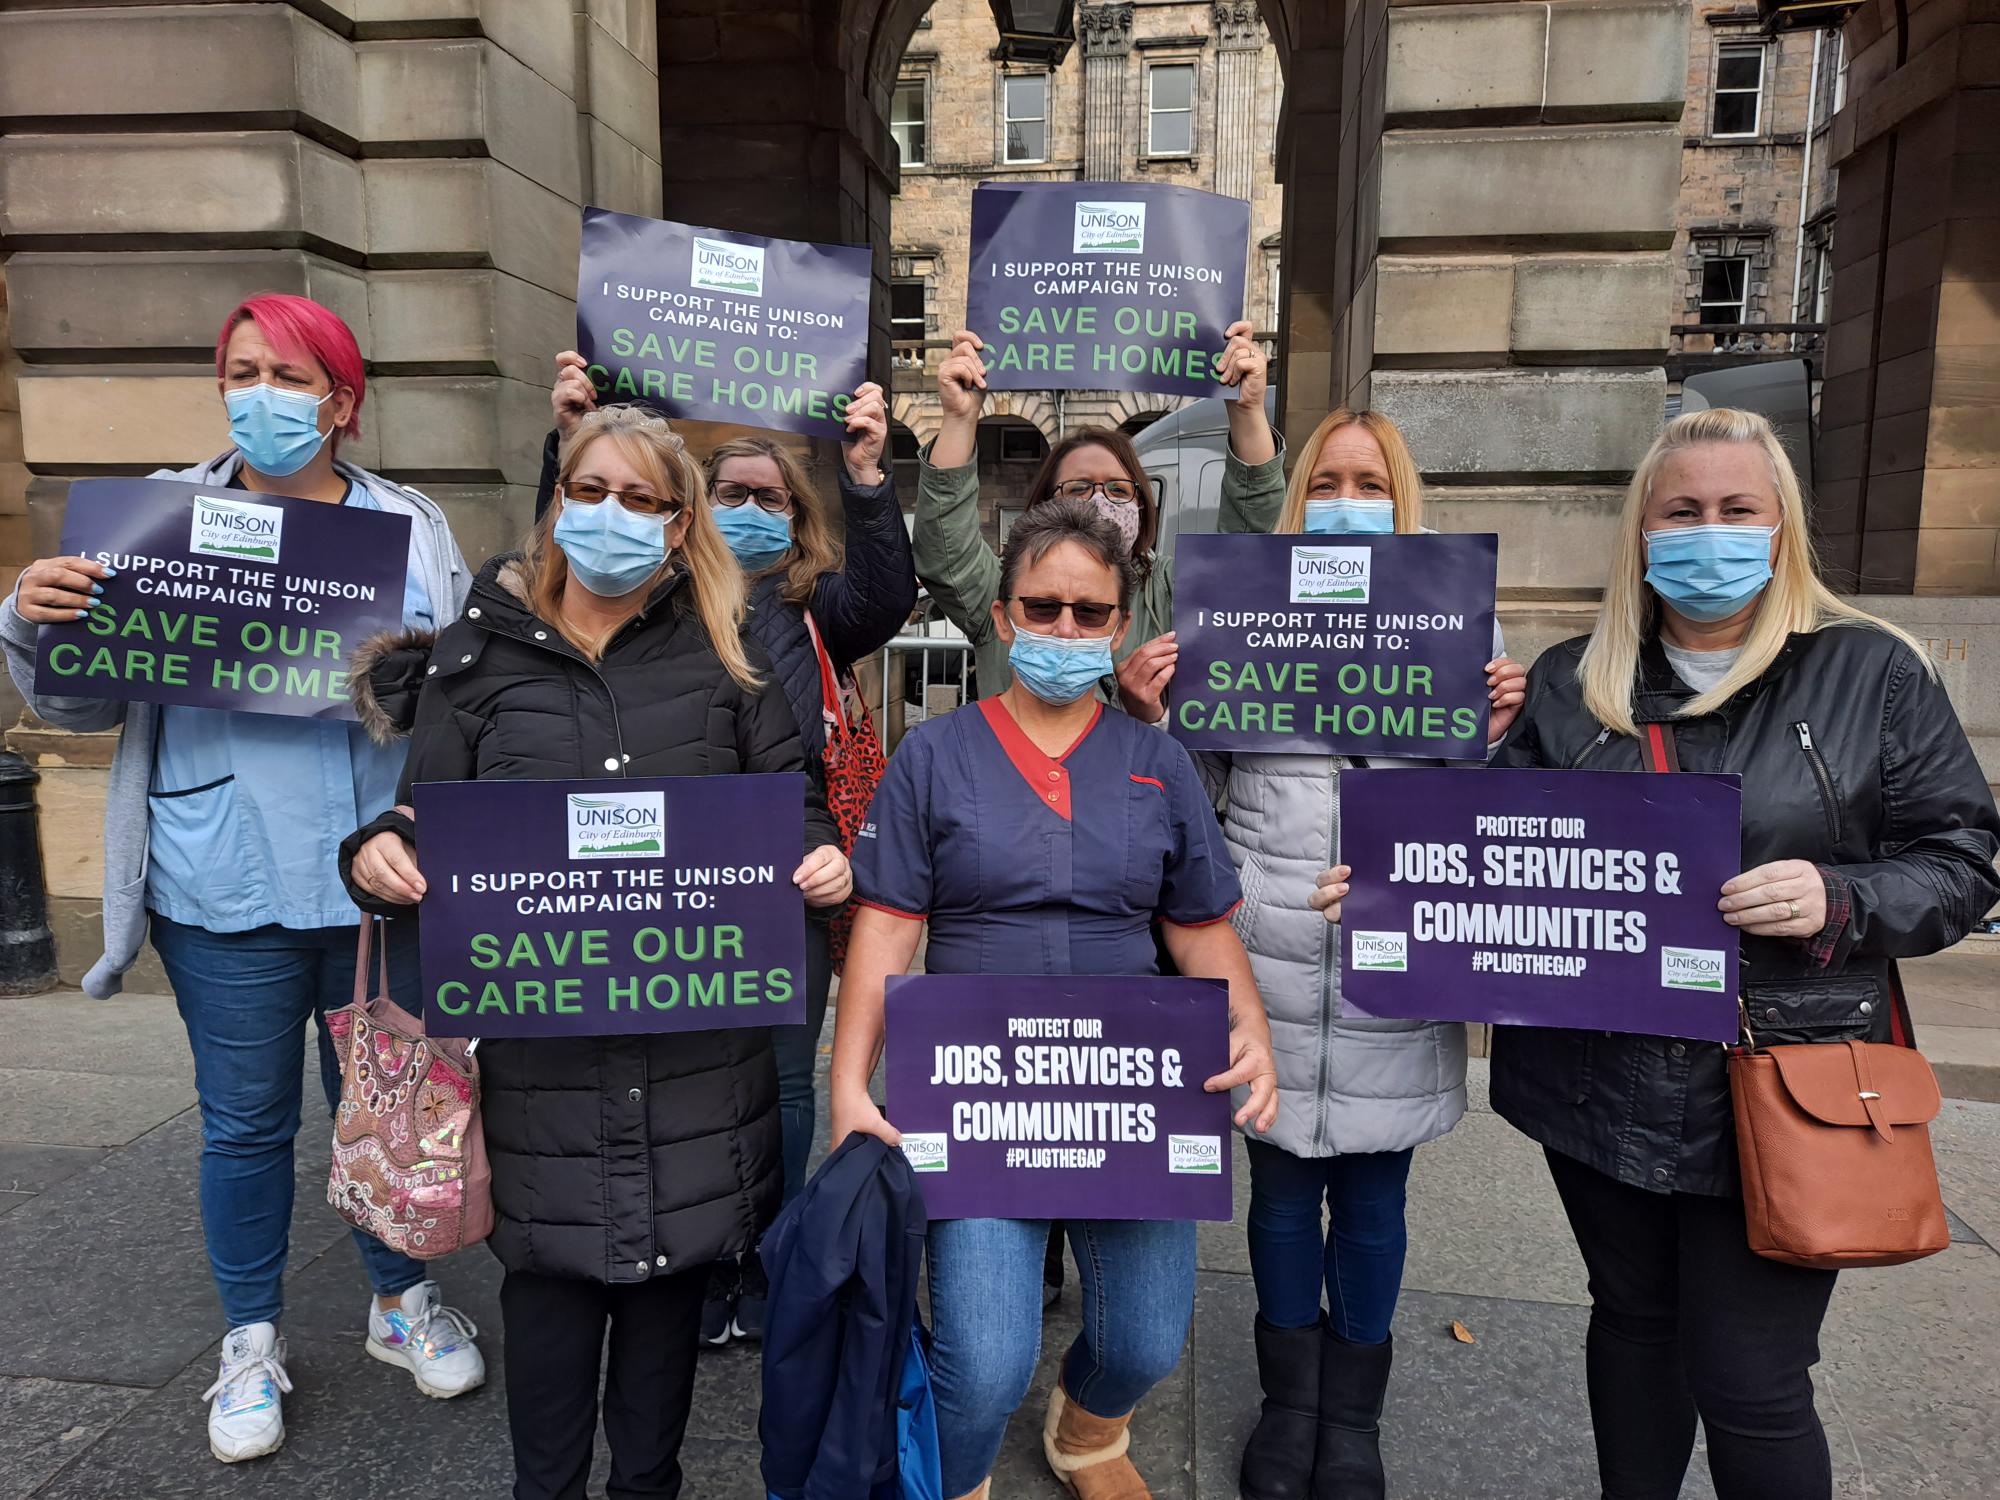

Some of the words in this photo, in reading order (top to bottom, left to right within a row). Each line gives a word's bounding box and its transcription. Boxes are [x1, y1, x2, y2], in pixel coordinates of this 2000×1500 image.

[1081, 214, 1139, 227] UNISON
[699, 251, 758, 271] UNISON
[992, 263, 996, 277] I
[1005, 262, 1096, 278] SUPPORT
[1103, 262, 1141, 277] THE
[1149, 264, 1222, 284] UNISON
[1034, 280, 1138, 295] CAMPAIGN
[1146, 282, 1177, 297] TO:
[603, 282, 609, 295] I
[617, 285, 715, 311] SUPPORT
[722, 300, 760, 318] THE
[768, 307, 844, 328] UNISON
[650, 308, 758, 335] CAMPAIGN
[766, 324, 798, 340] TO:
[999, 307, 1097, 334] SAVE
[1114, 307, 1198, 340] OUR
[611, 328, 716, 368] SAVE
[734, 346, 818, 380] OUR
[587, 364, 694, 400] CARE
[712, 378, 851, 424] HOMES
[201, 511, 275, 534] UNISON
[201, 529, 219, 539] City
[221, 533, 232, 541] of
[233, 533, 278, 547] Edinburgh
[96, 552, 219, 580] SUPPORT
[229, 567, 275, 589] THE
[285, 576, 375, 601] UNISON
[1298, 560, 1364, 574] UNISON
[136, 578, 272, 608] CAMPAIGN
[281, 595, 320, 614] TO:
[1299, 579, 1315, 587] City
[1317, 579, 1326, 588] of
[1327, 579, 1367, 589] Edinburgh
[87, 603, 219, 648] SAVE
[240, 621, 343, 660] OUR
[1198, 611, 1203, 626] I
[1212, 612, 1316, 629] SUPPORT
[1324, 613, 1367, 629] THE
[1376, 614, 1464, 631] UNISON
[1246, 633, 1364, 649] CAMPAIGN
[1373, 634, 1410, 650] TO:
[48, 643, 191, 687] CARE
[211, 658, 351, 701] HOME
[1208, 660, 1319, 694] SAVE
[1337, 663, 1434, 696] OUR
[1179, 699, 1295, 734] CARE
[1314, 704, 1478, 740] HOMES
[577, 808, 656, 826] UNISON
[1476, 815, 1546, 838] PROTECT
[1551, 817, 1585, 839] OUR
[579, 830, 598, 841] City
[601, 830, 612, 840] of
[613, 829, 662, 839] Edinburgh
[452, 875, 458, 892] I
[471, 871, 603, 892] SUPPORT
[612, 869, 664, 888] THE
[674, 865, 774, 886] UNISON
[1389, 842, 1475, 888] JOBS,
[1483, 845, 1646, 893] SERVICES
[1654, 852, 1683, 895] &
[516, 892, 662, 915] CAMPAIGN
[672, 891, 716, 910] TO:
[1413, 900, 1647, 954] COMMUNITIES
[470, 929, 610, 969] SAVE
[632, 924, 745, 964] OUR
[1357, 940, 1402, 952] UNISON
[1472, 951, 1587, 978] #PLUGTHEGAP
[1667, 957, 1720, 971] UNISON
[436, 978, 584, 1015] CARE
[608, 967, 794, 1012] HOMES
[1008, 1018, 1070, 1038] PROTECT
[1073, 1019, 1102, 1039] OUR
[930, 1045, 1008, 1088] JOBS,
[1015, 1047, 1154, 1087] SERVICES
[1161, 1048, 1184, 1088] &
[952, 1101, 1156, 1143] COMMUNITIES
[1006, 1148, 1106, 1169] #PLUGTHEGAP
[1173, 1144, 1216, 1155] UNISON
